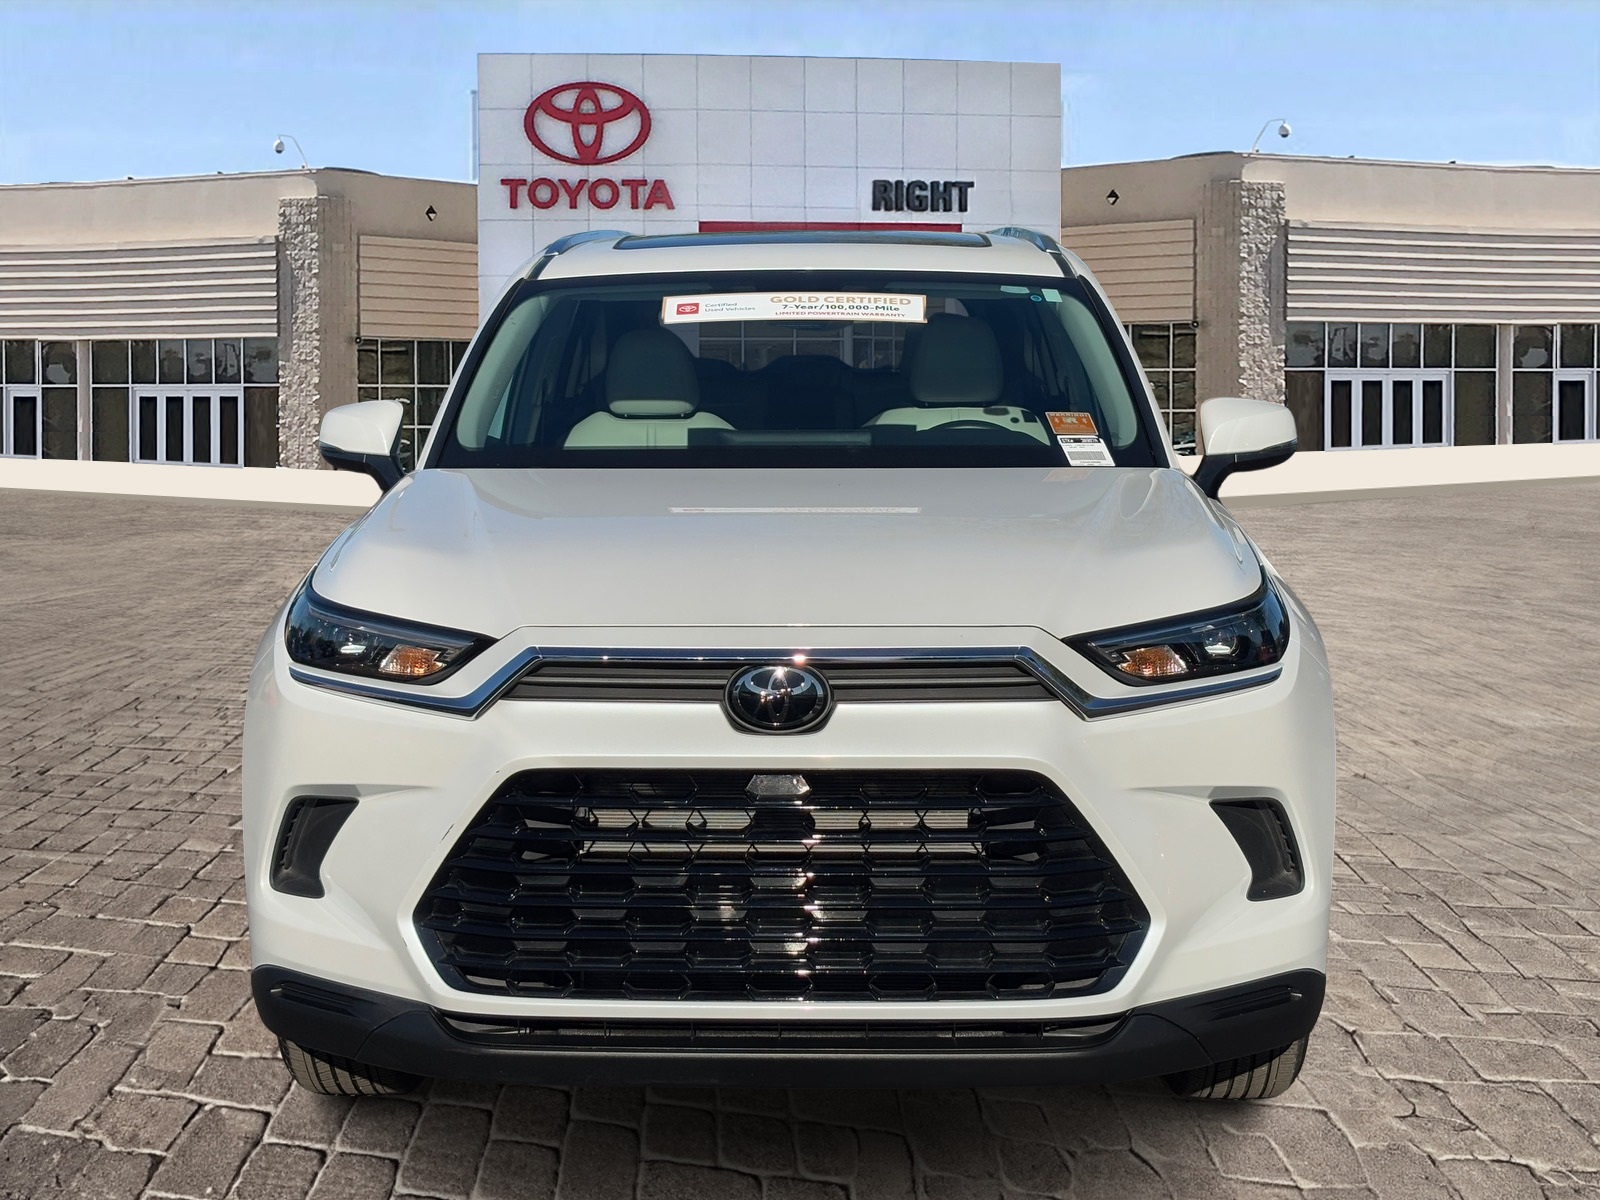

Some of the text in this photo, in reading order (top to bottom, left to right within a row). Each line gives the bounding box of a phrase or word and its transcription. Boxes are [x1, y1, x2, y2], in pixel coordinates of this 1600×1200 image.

[500, 177, 676, 210] TOYOTA
[872, 179, 975, 213] RIGHT
[782, 304, 900, 312] 7-Year/100,000-Mile
[823, 296, 912, 306] CERTIFIED
